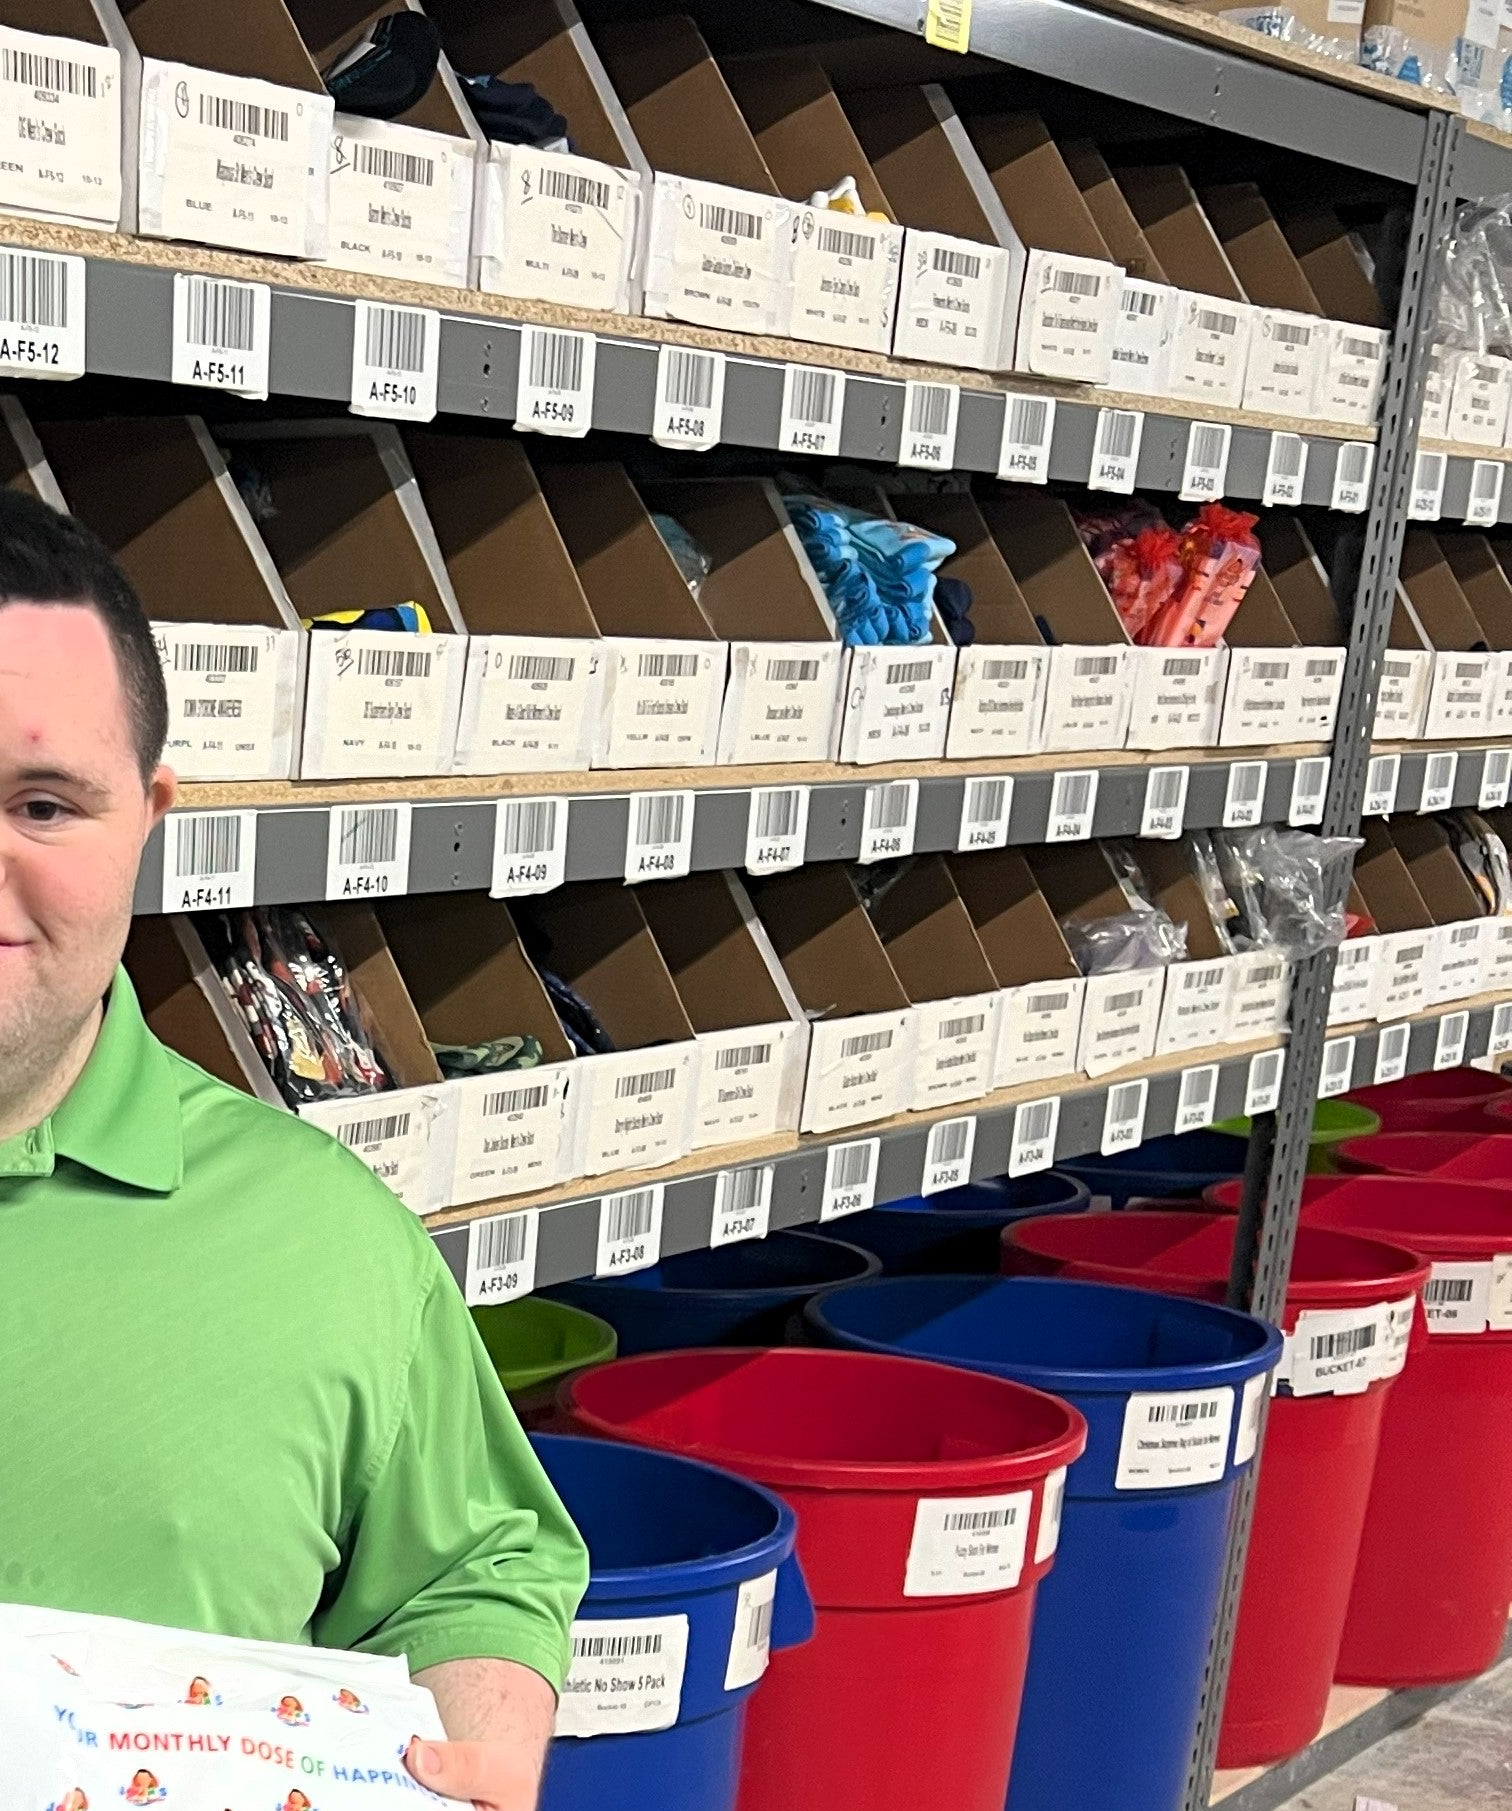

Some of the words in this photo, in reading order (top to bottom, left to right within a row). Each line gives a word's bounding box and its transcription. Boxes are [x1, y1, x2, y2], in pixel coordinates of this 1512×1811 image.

[0, 338, 59, 366] A-F5-12
[192, 360, 245, 386] A-F5-11
[369, 381, 417, 405] A-F5-10
[532, 400, 574, 423] A-F5-09
[667, 416, 705, 437] A-F5-08
[166, 740, 192, 748] URPL
[507, 864, 547, 884] A-F4-09
[638, 855, 675, 873] A-F4-08
[342, 876, 388, 895] A-F4-10
[181, 888, 231, 909] A-F4-11
[723, 1217, 755, 1238] A-F3-07
[608, 1245, 645, 1267] A-F3-08
[479, 1273, 518, 1297] A-F3-09
[562, 1678, 591, 1693] thletic
[594, 1679, 608, 1692] No
[610, 1677, 635, 1691] Show
[638, 1676, 643, 1690] 5
[645, 1674, 666, 1690] Pack
[109, 1731, 232, 1753] MONTHLY
[241, 1736, 296, 1770] DOSE
[301, 1755, 326, 1777] OF
